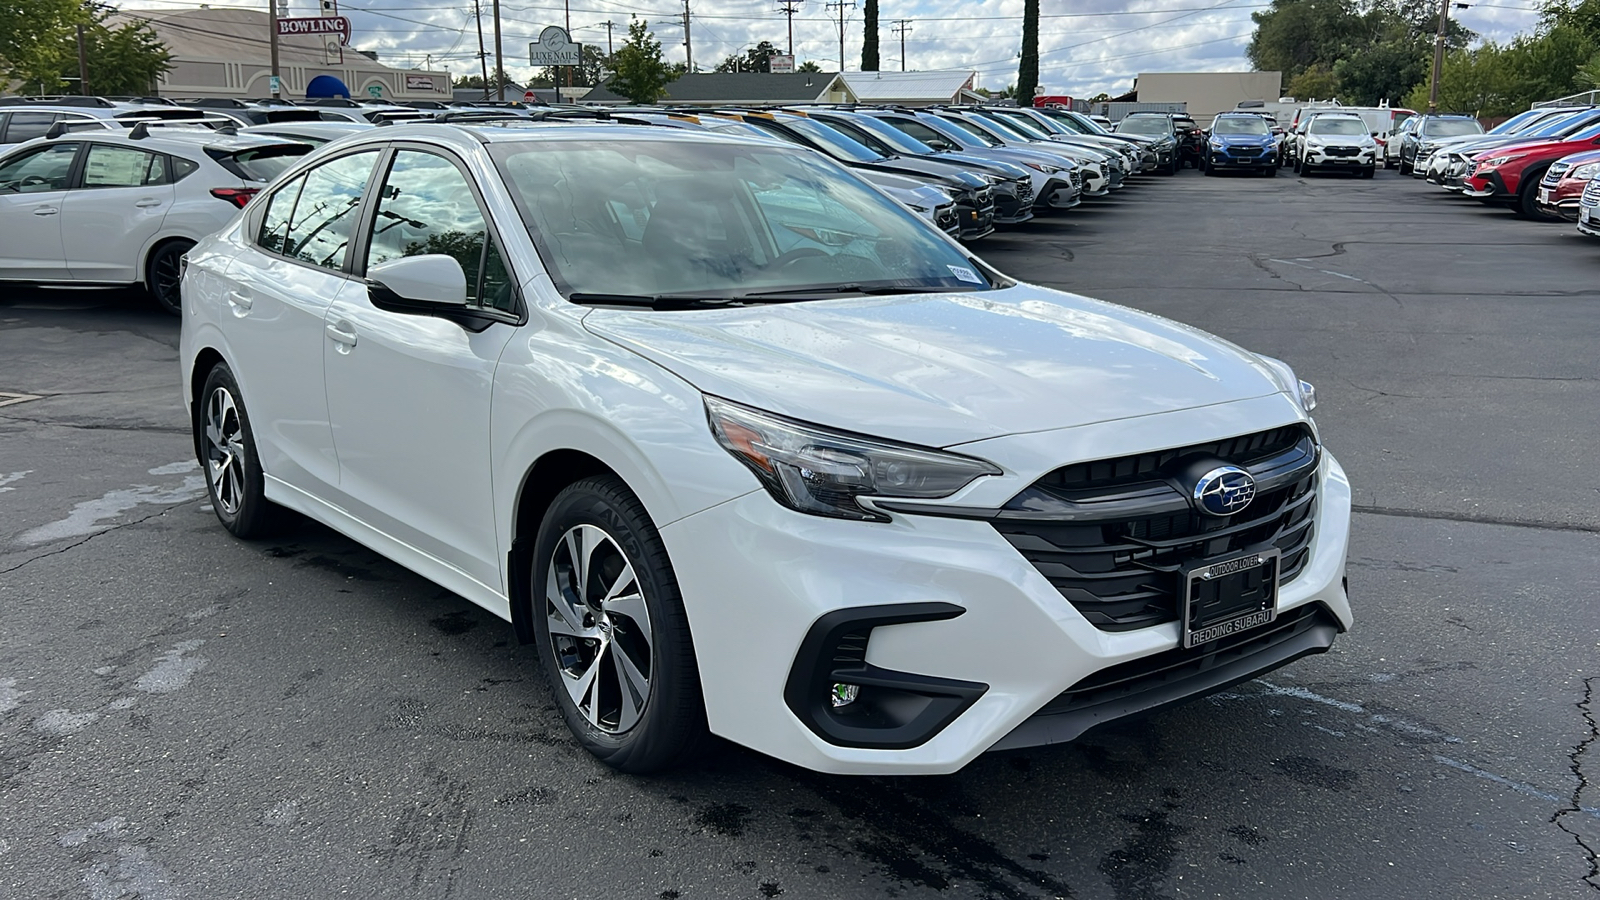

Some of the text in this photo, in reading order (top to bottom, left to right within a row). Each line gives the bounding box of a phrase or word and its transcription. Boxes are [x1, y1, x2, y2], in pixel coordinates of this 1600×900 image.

[279, 19, 345, 33] BOWLING
[531, 52, 578, 60] LUXE NAILS
[598, 508, 641, 560] AVID
[1210, 556, 1258, 576] OUTDOOR LOVER
[1193, 611, 1270, 644] REDDING SUBARU
